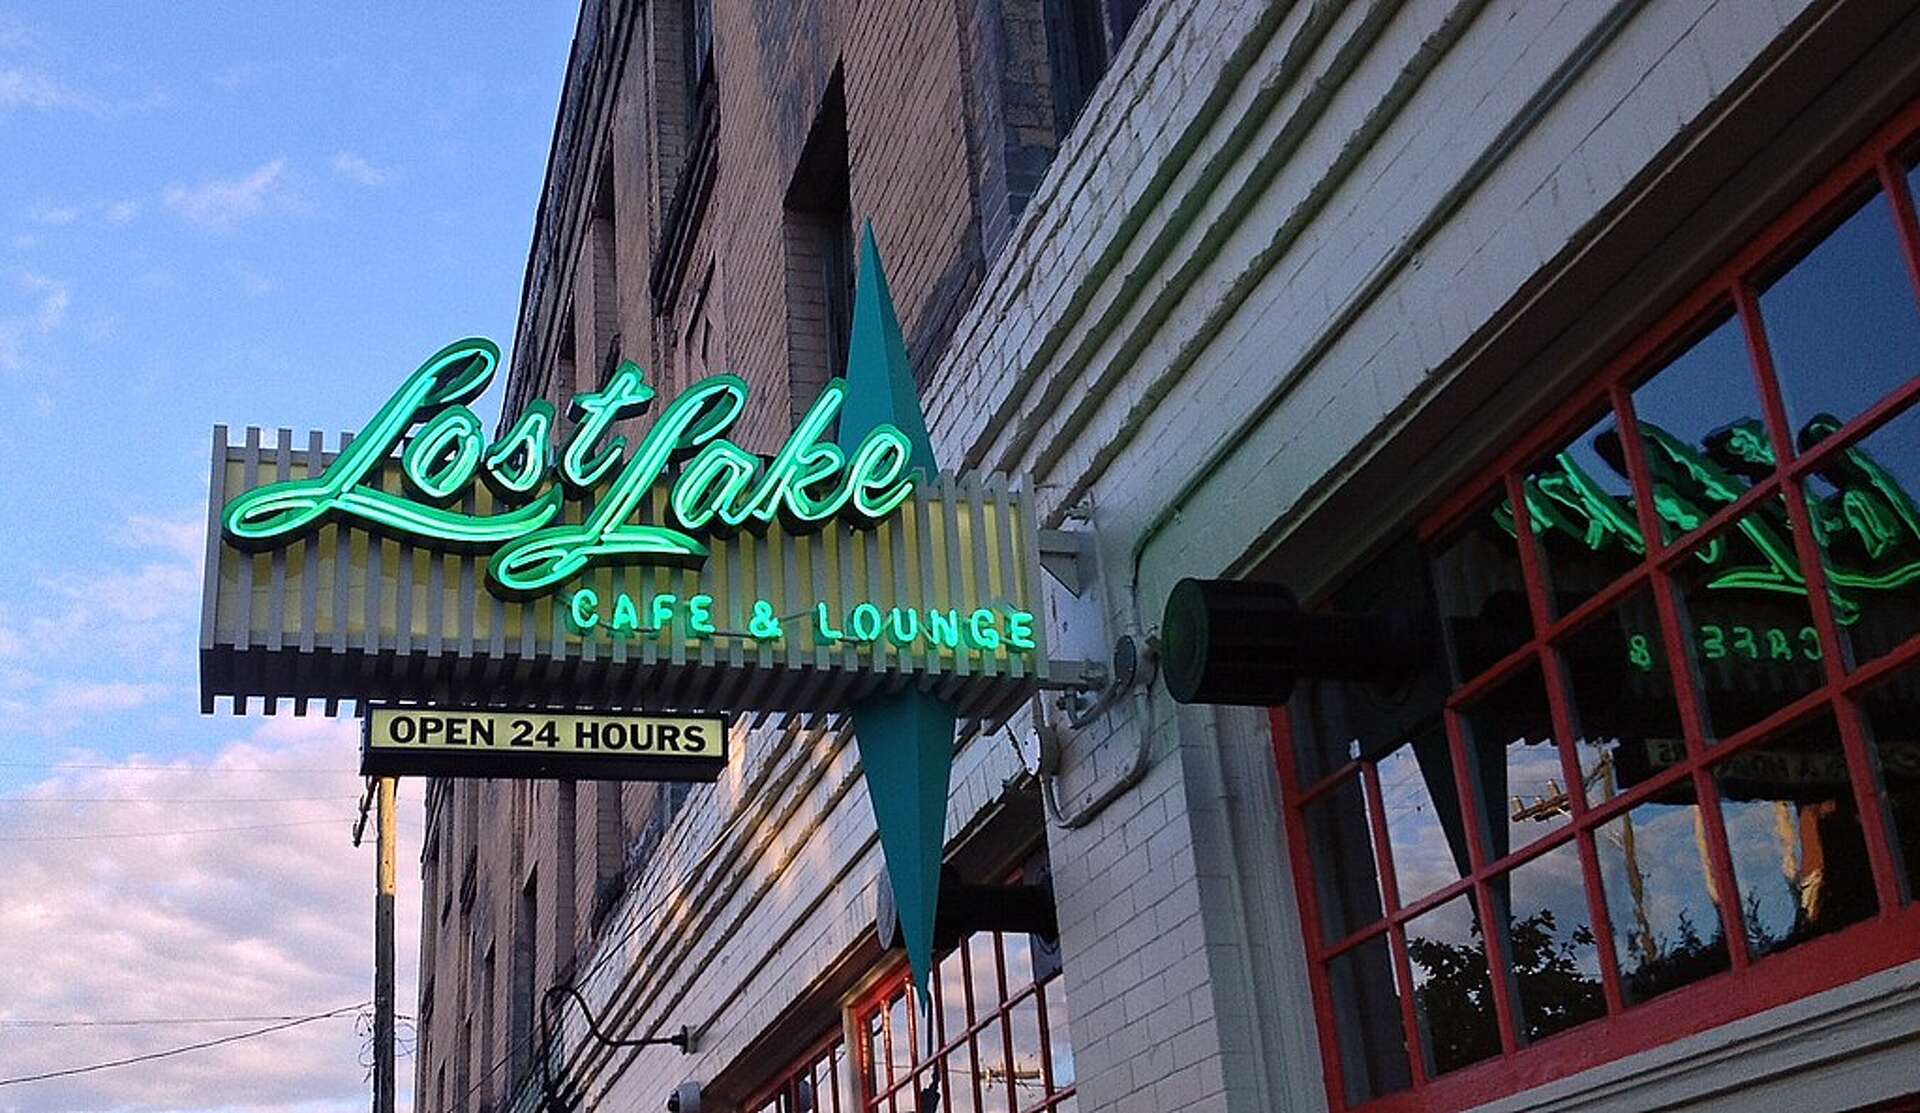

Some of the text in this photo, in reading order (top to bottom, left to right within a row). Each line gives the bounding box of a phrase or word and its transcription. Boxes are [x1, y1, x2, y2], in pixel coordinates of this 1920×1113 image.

[222, 337, 922, 595] Lost Lake
[571, 588, 1036, 650] CAFE & LOUNGE
[389, 716, 707, 752] OPEN 24 HOURS
